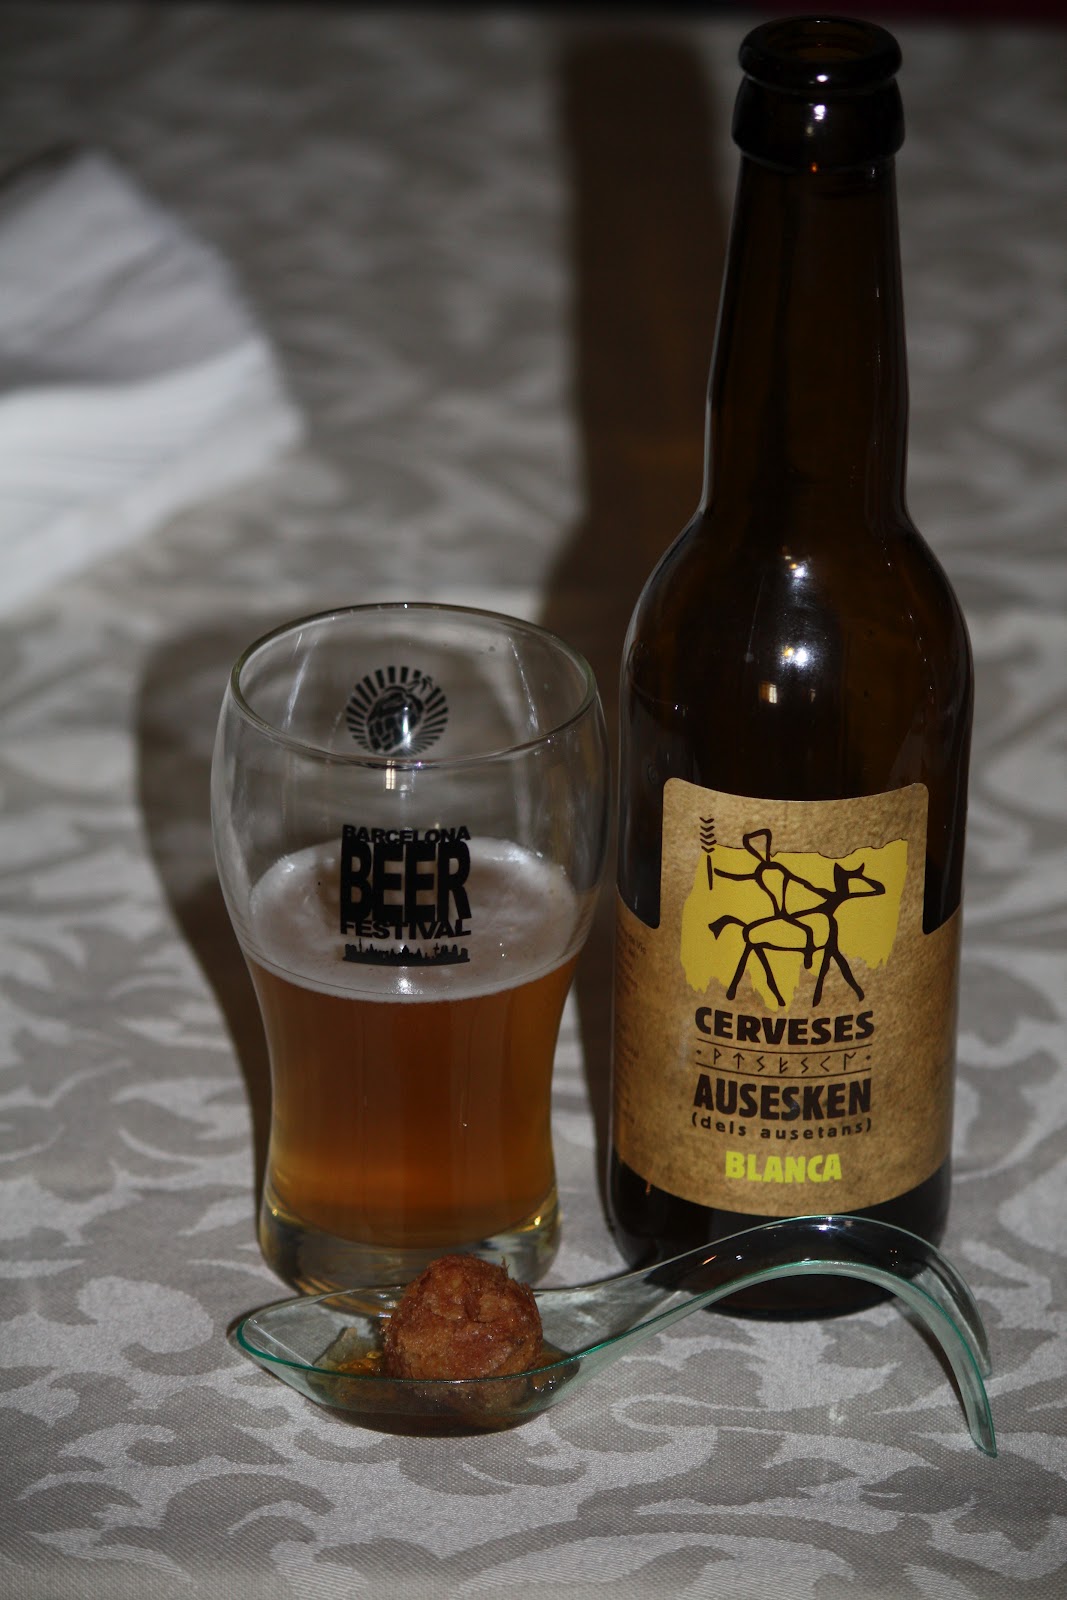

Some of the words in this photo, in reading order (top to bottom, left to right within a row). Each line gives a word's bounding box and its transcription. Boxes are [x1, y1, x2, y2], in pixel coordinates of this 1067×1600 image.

[342, 824, 471, 844] BARCELONA
[340, 839, 472, 922] BEER
[340, 918, 472, 940] FESTIVAL
[695, 1006, 875, 1046] CERVESES
[693, 1073, 872, 1121] AUSESKEN
[691, 1111, 747, 1137] (dels
[760, 1117, 872, 1140] ausetans)
[725, 1150, 842, 1184] BLANCA
